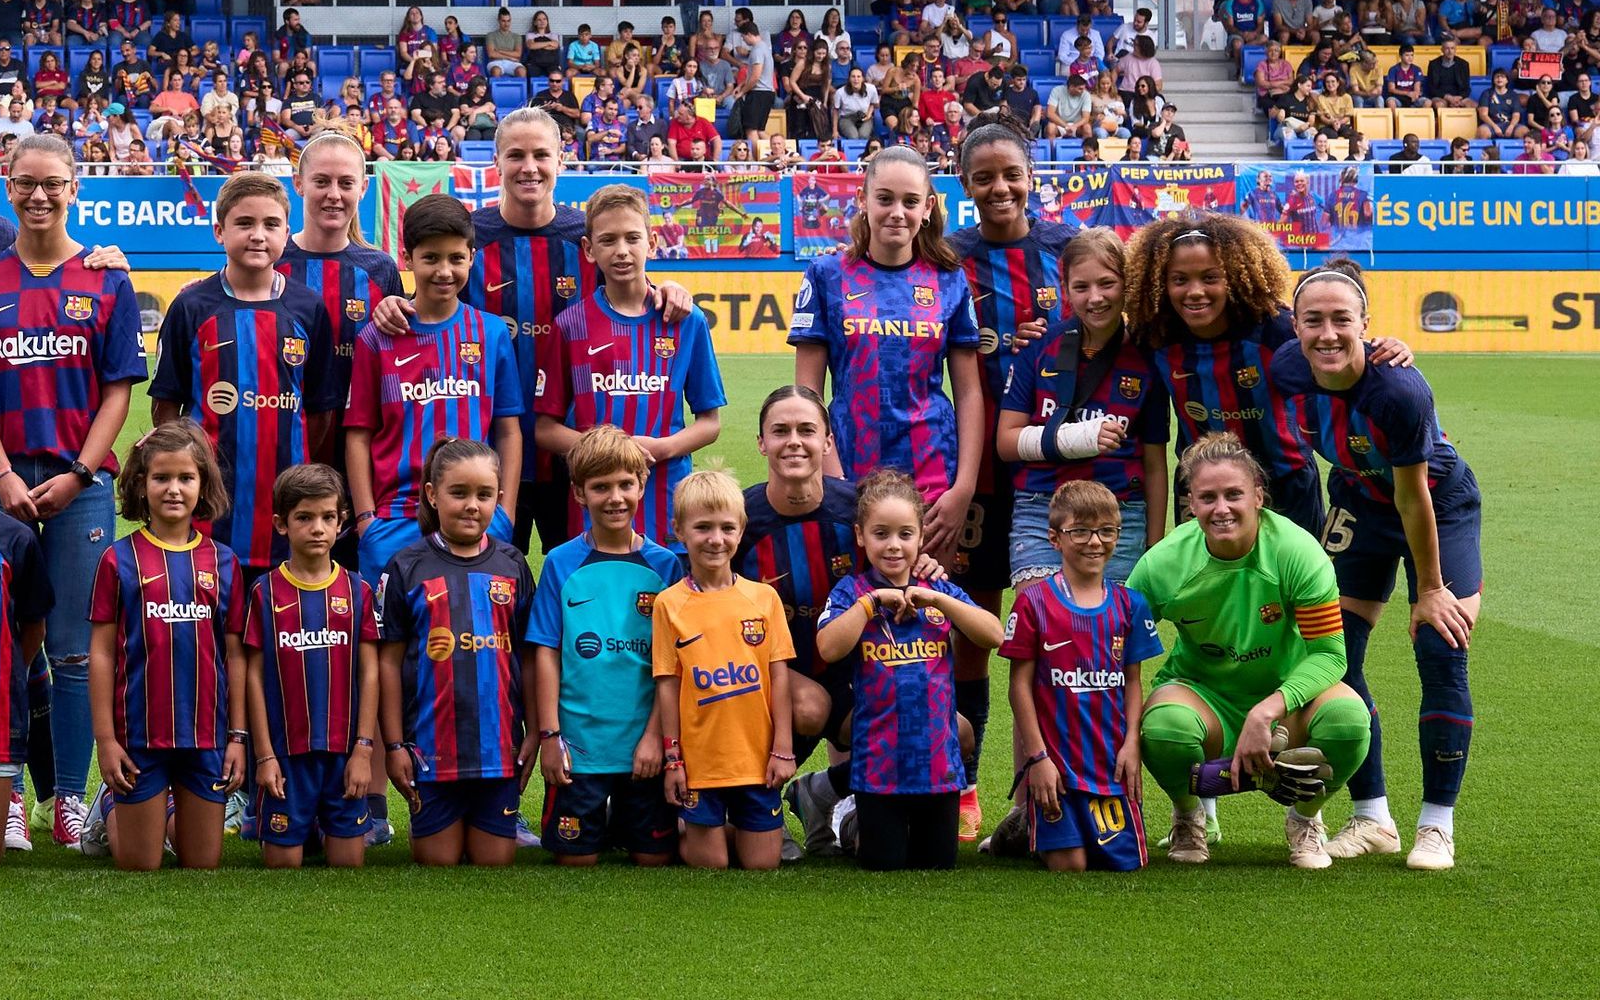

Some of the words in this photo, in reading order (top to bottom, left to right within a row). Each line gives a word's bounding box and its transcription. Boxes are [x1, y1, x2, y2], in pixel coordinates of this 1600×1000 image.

[1535, 53, 1562, 62] VENDE
[727, 174, 776, 183] SANDRA
[1120, 166, 1149, 180] PEP
[1153, 166, 1225, 181] VENTURA
[653, 183, 694, 194] MARTA
[747, 186, 756, 201] 1
[77, 200, 112, 226] FC
[659, 195, 672, 210] 8
[1070, 197, 1110, 211] DREAMS
[1417, 200, 1475, 232] QUE
[1482, 200, 1522, 227] UN
[1530, 200, 1600, 227] CLUB
[687, 225, 732, 235] ALEXIA
[704, 238, 719, 253] 11
[842, 318, 945, 340] STANLEY
[400, 375, 480, 402] Rakuten
[242, 390, 301, 412] Spotify
[1211, 406, 1265, 424] Spotify
[1320, 506, 1358, 553] 15
[146, 599, 212, 619] Rakuten
[279, 627, 348, 649] Rakuten
[459, 631, 512, 653] Spotify
[605, 636, 652, 658] Spotify
[862, 637, 948, 664] Rakuten
[1228, 644, 1272, 664] Spotify
[692, 661, 760, 691] beko
[1050, 667, 1126, 689] Rakuten
[1088, 796, 1126, 835] 10
